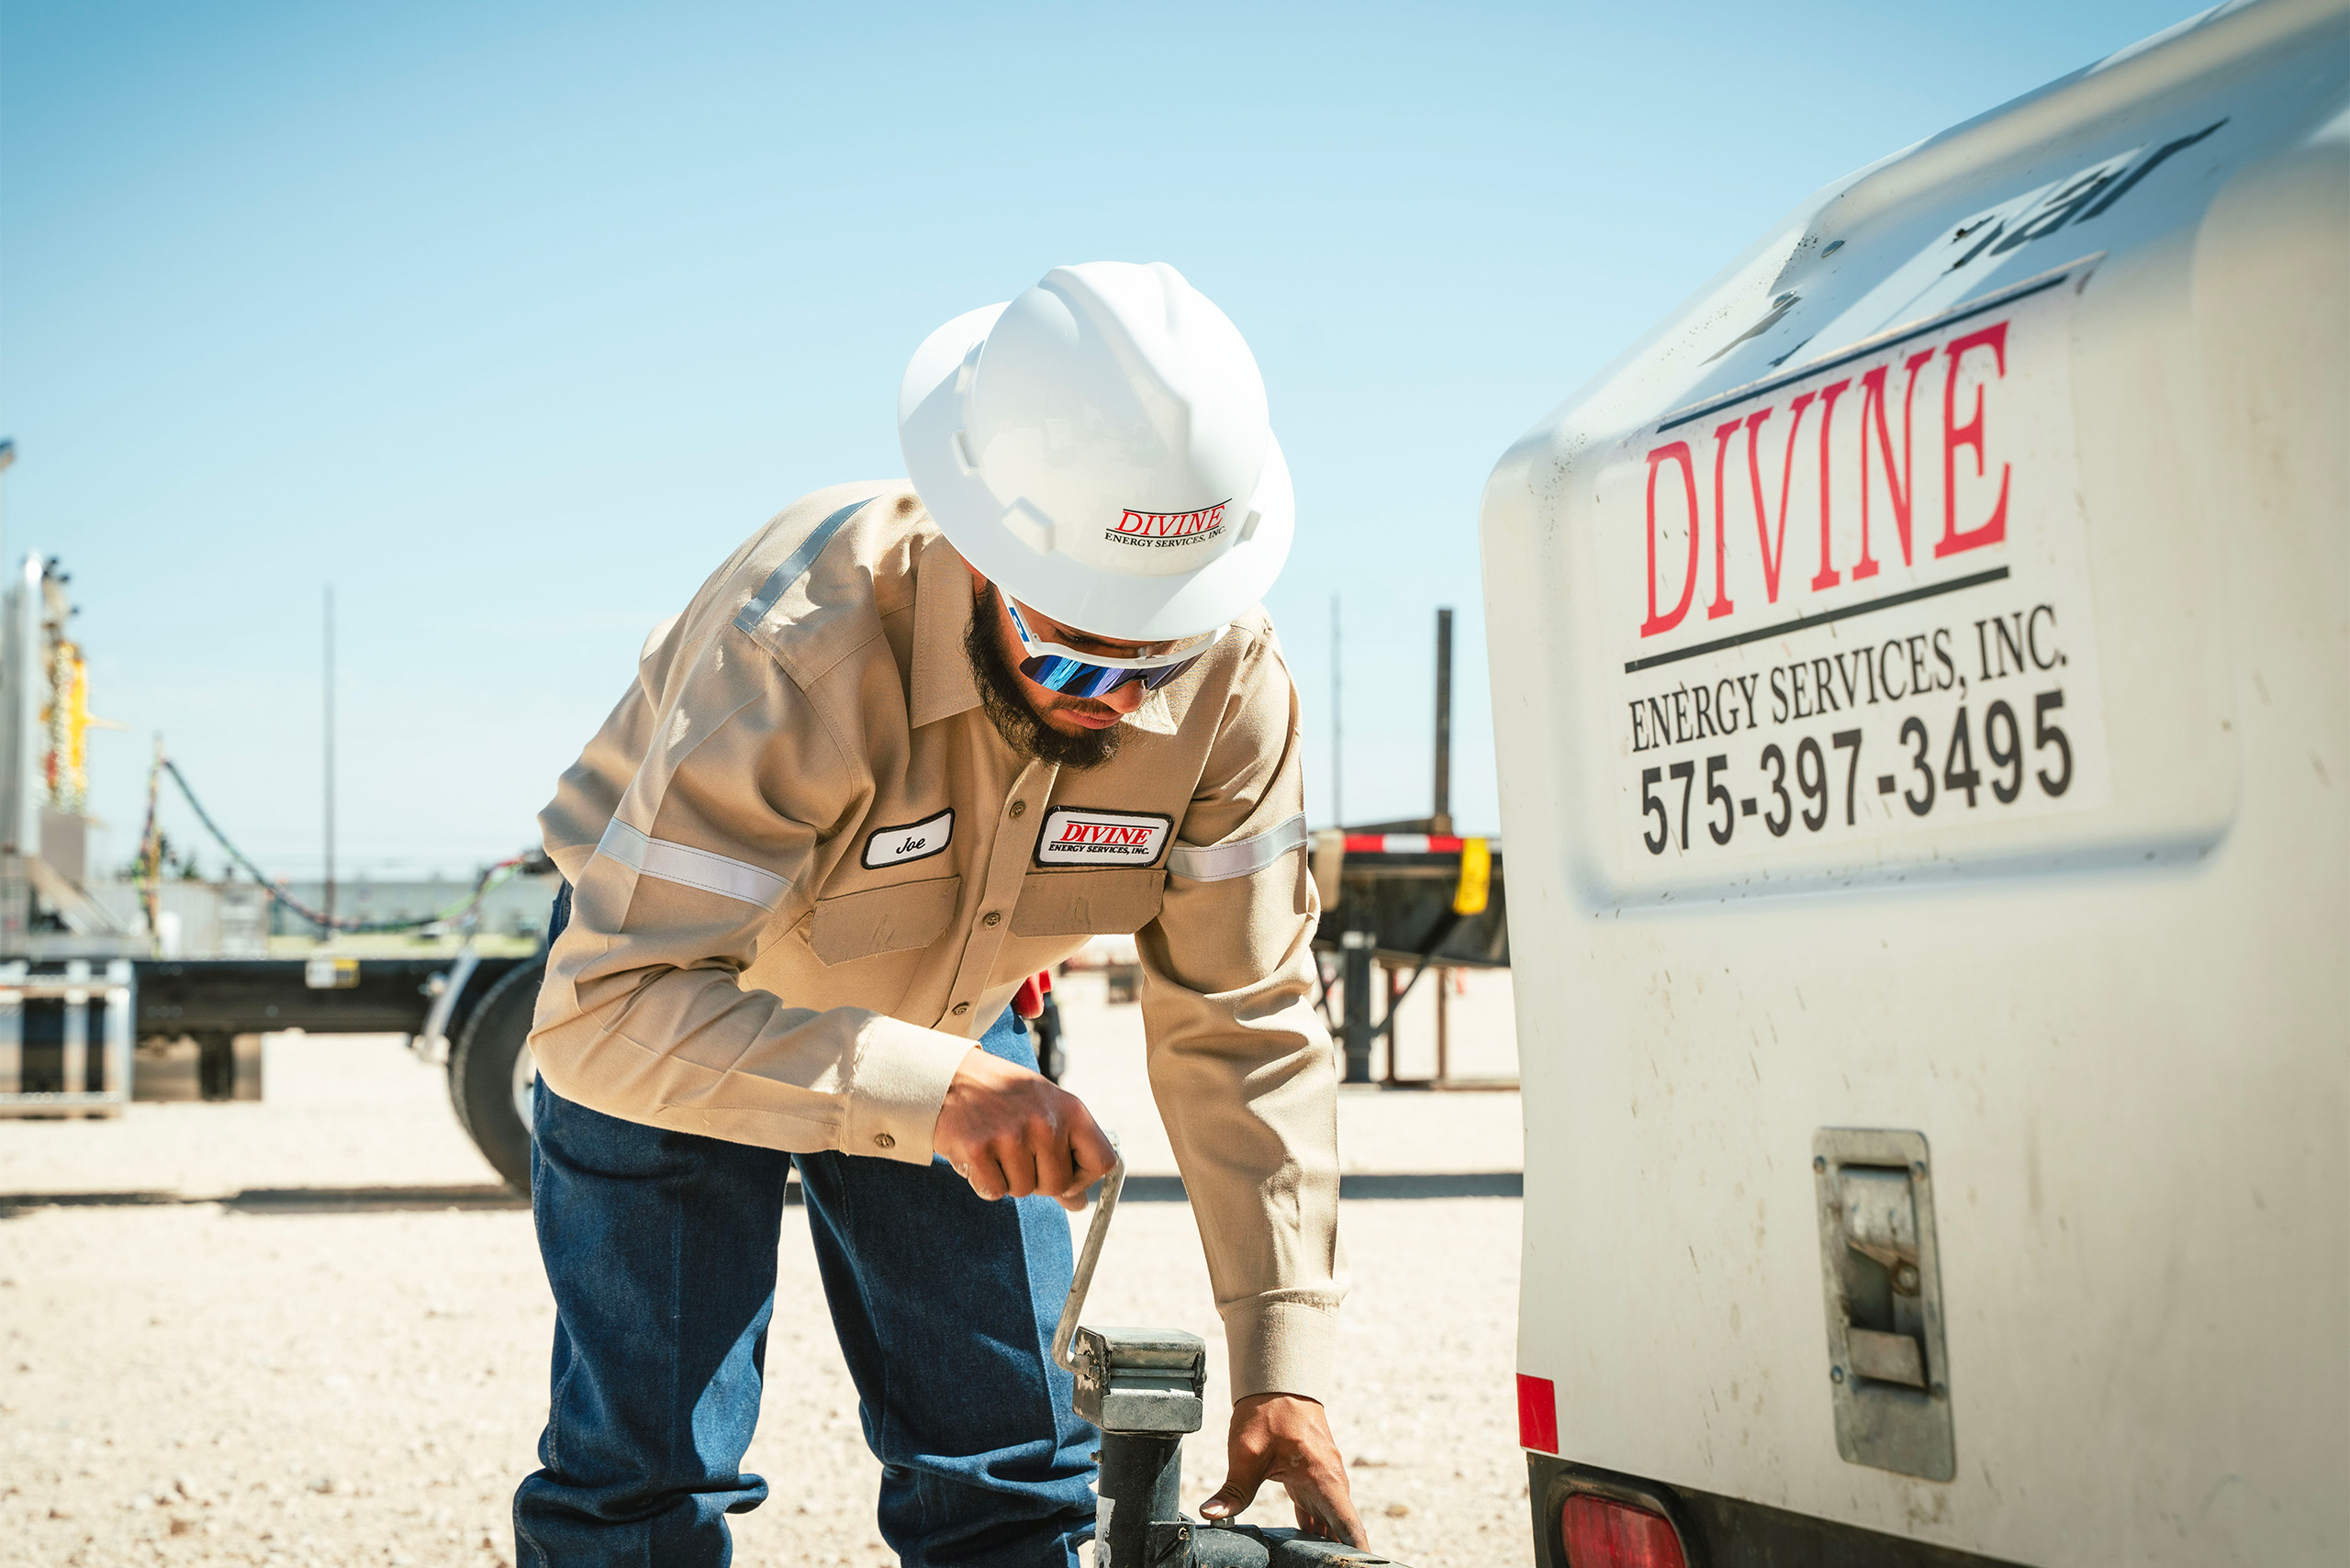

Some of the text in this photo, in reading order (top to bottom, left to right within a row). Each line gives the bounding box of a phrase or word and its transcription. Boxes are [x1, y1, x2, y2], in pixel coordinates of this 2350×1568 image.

[1640, 319, 2011, 639] DIVINE
[1114, 504, 1225, 536] DIVINE
[1104, 526, 1226, 548] ENERGY SERVICES, INC.
[1628, 603, 2068, 753] ENERGY SERVICES, INC.
[1641, 688, 2074, 856] 575-397-3495
[896, 836, 926, 855] Joe
[1059, 823, 1153, 846] DIVINE
[1048, 844, 1086, 853] ENERGY
[1086, 846, 1130, 855] SERVICES,
